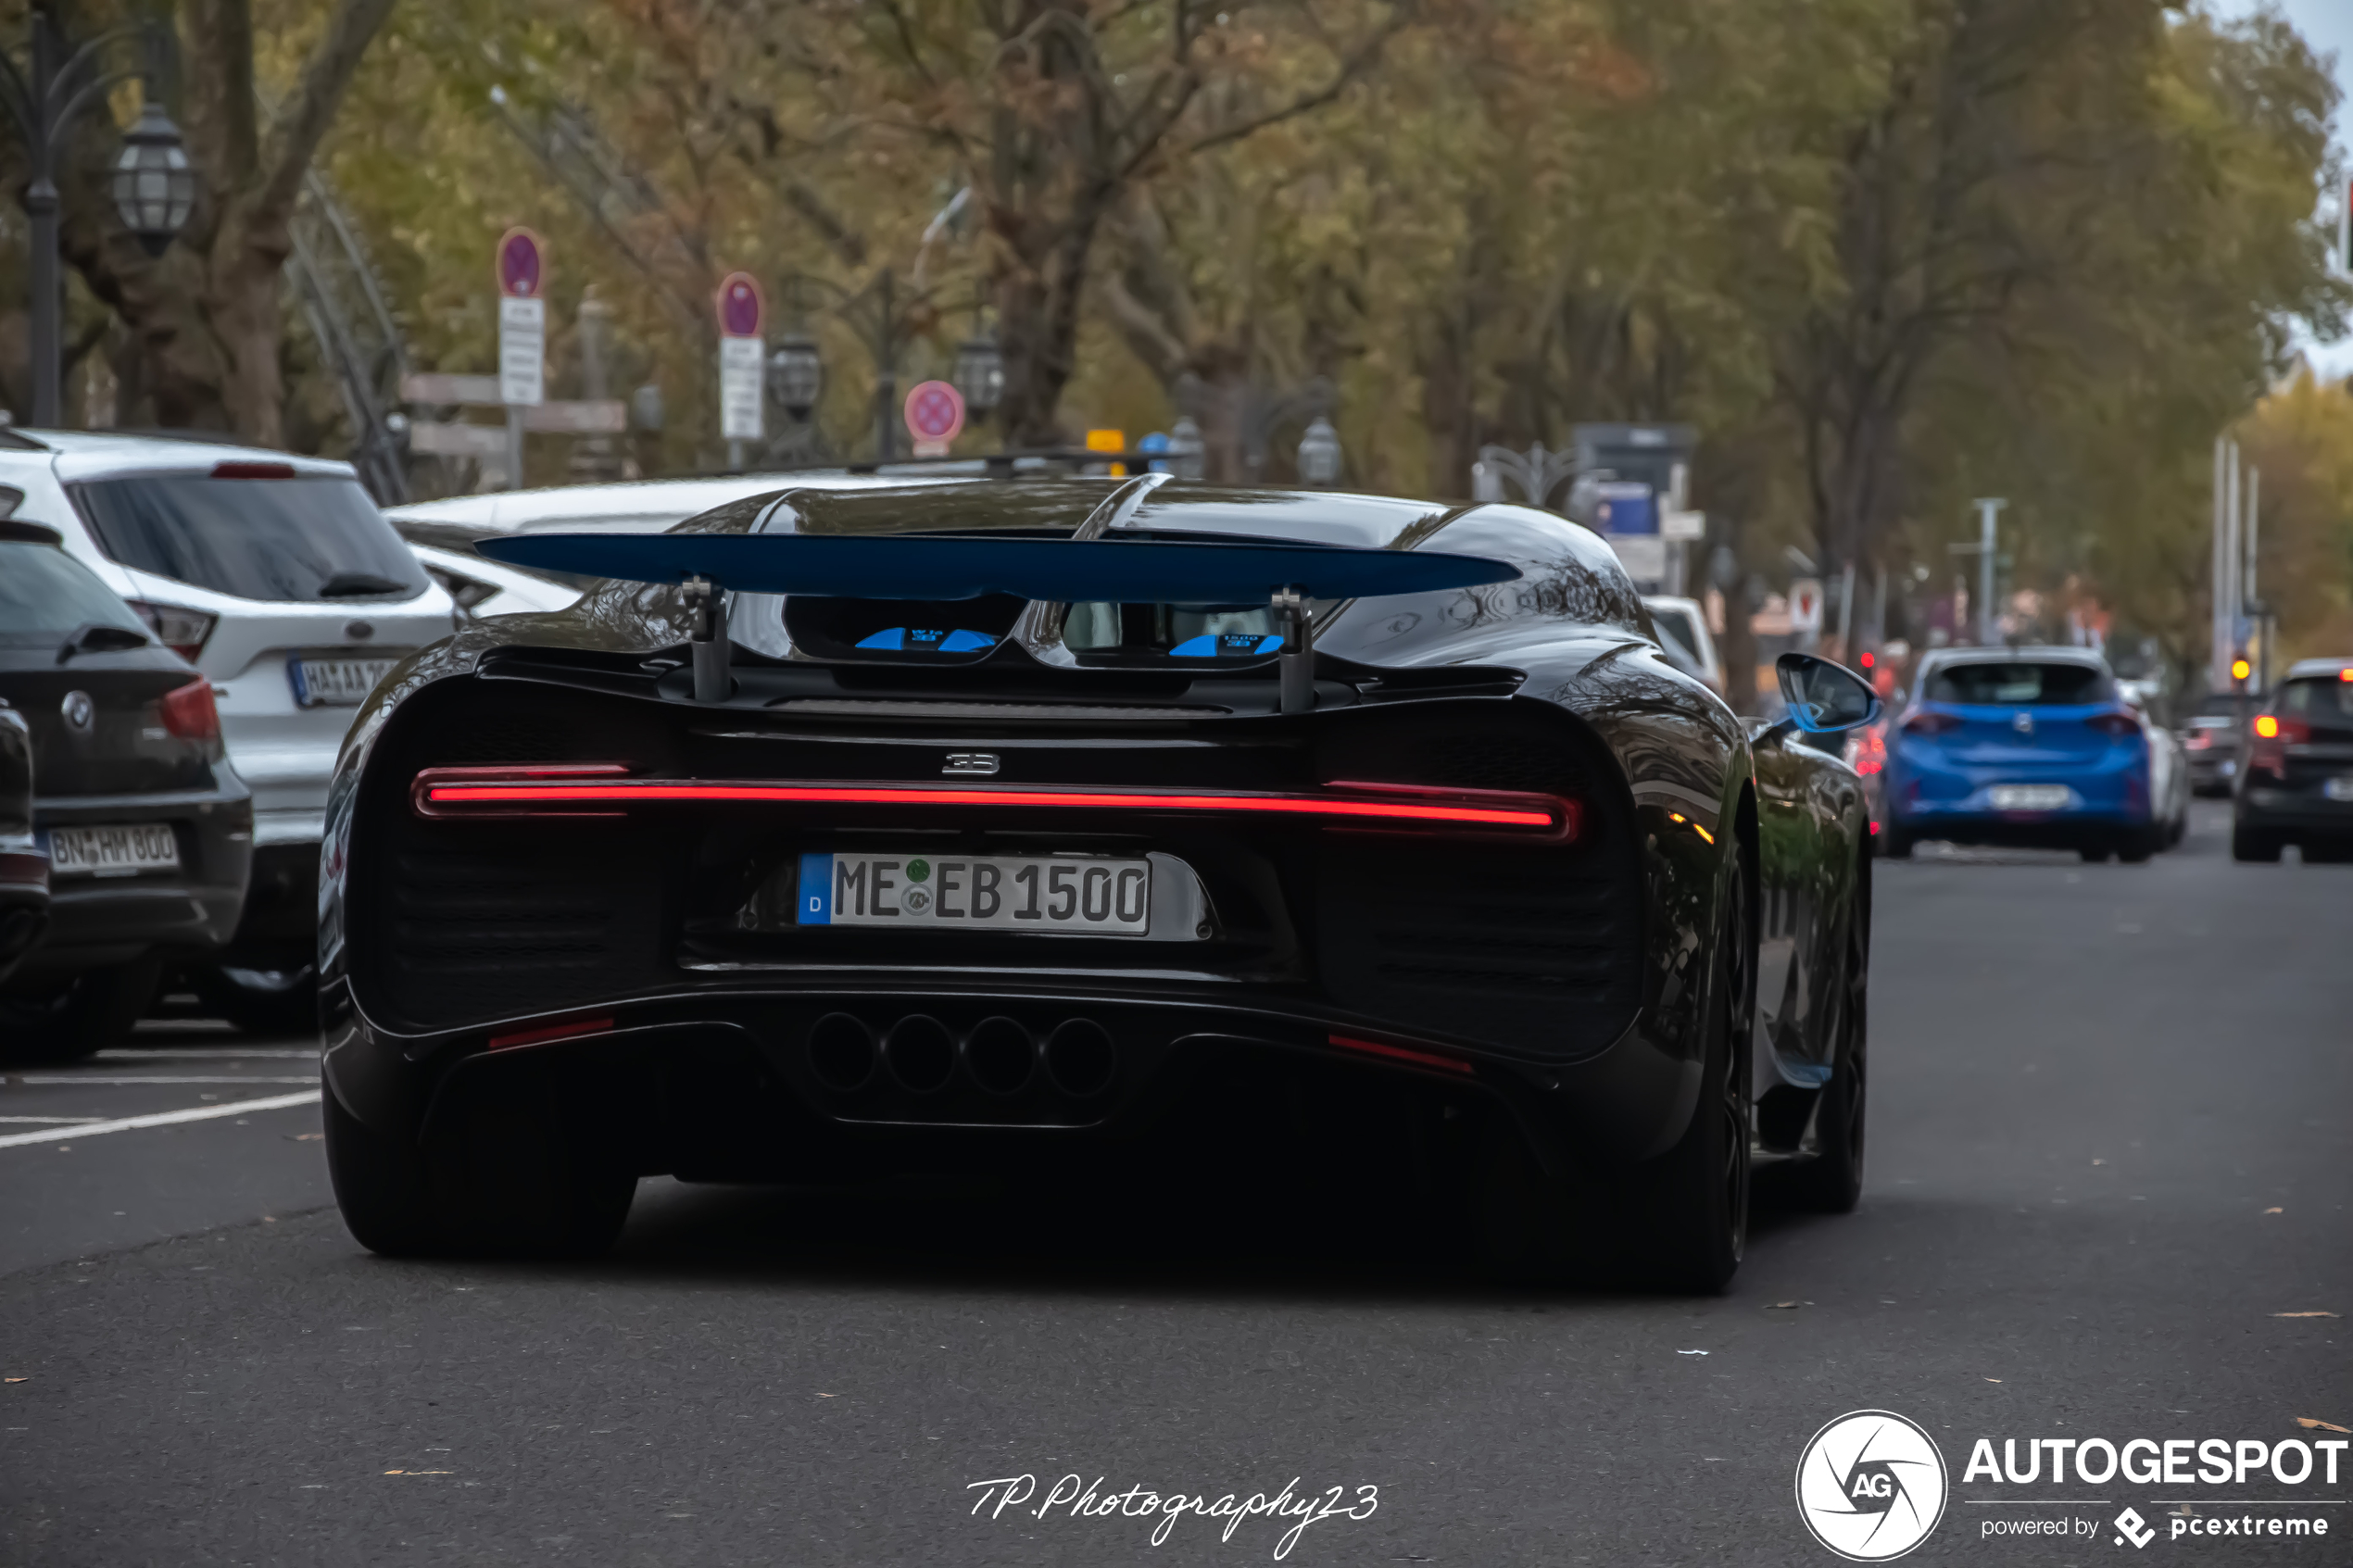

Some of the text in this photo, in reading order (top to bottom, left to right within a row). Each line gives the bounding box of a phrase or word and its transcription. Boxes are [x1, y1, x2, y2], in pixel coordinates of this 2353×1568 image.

[52, 832, 84, 864] BN
[810, 897, 821, 912] D
[836, 860, 1146, 922] ME EB 1500
